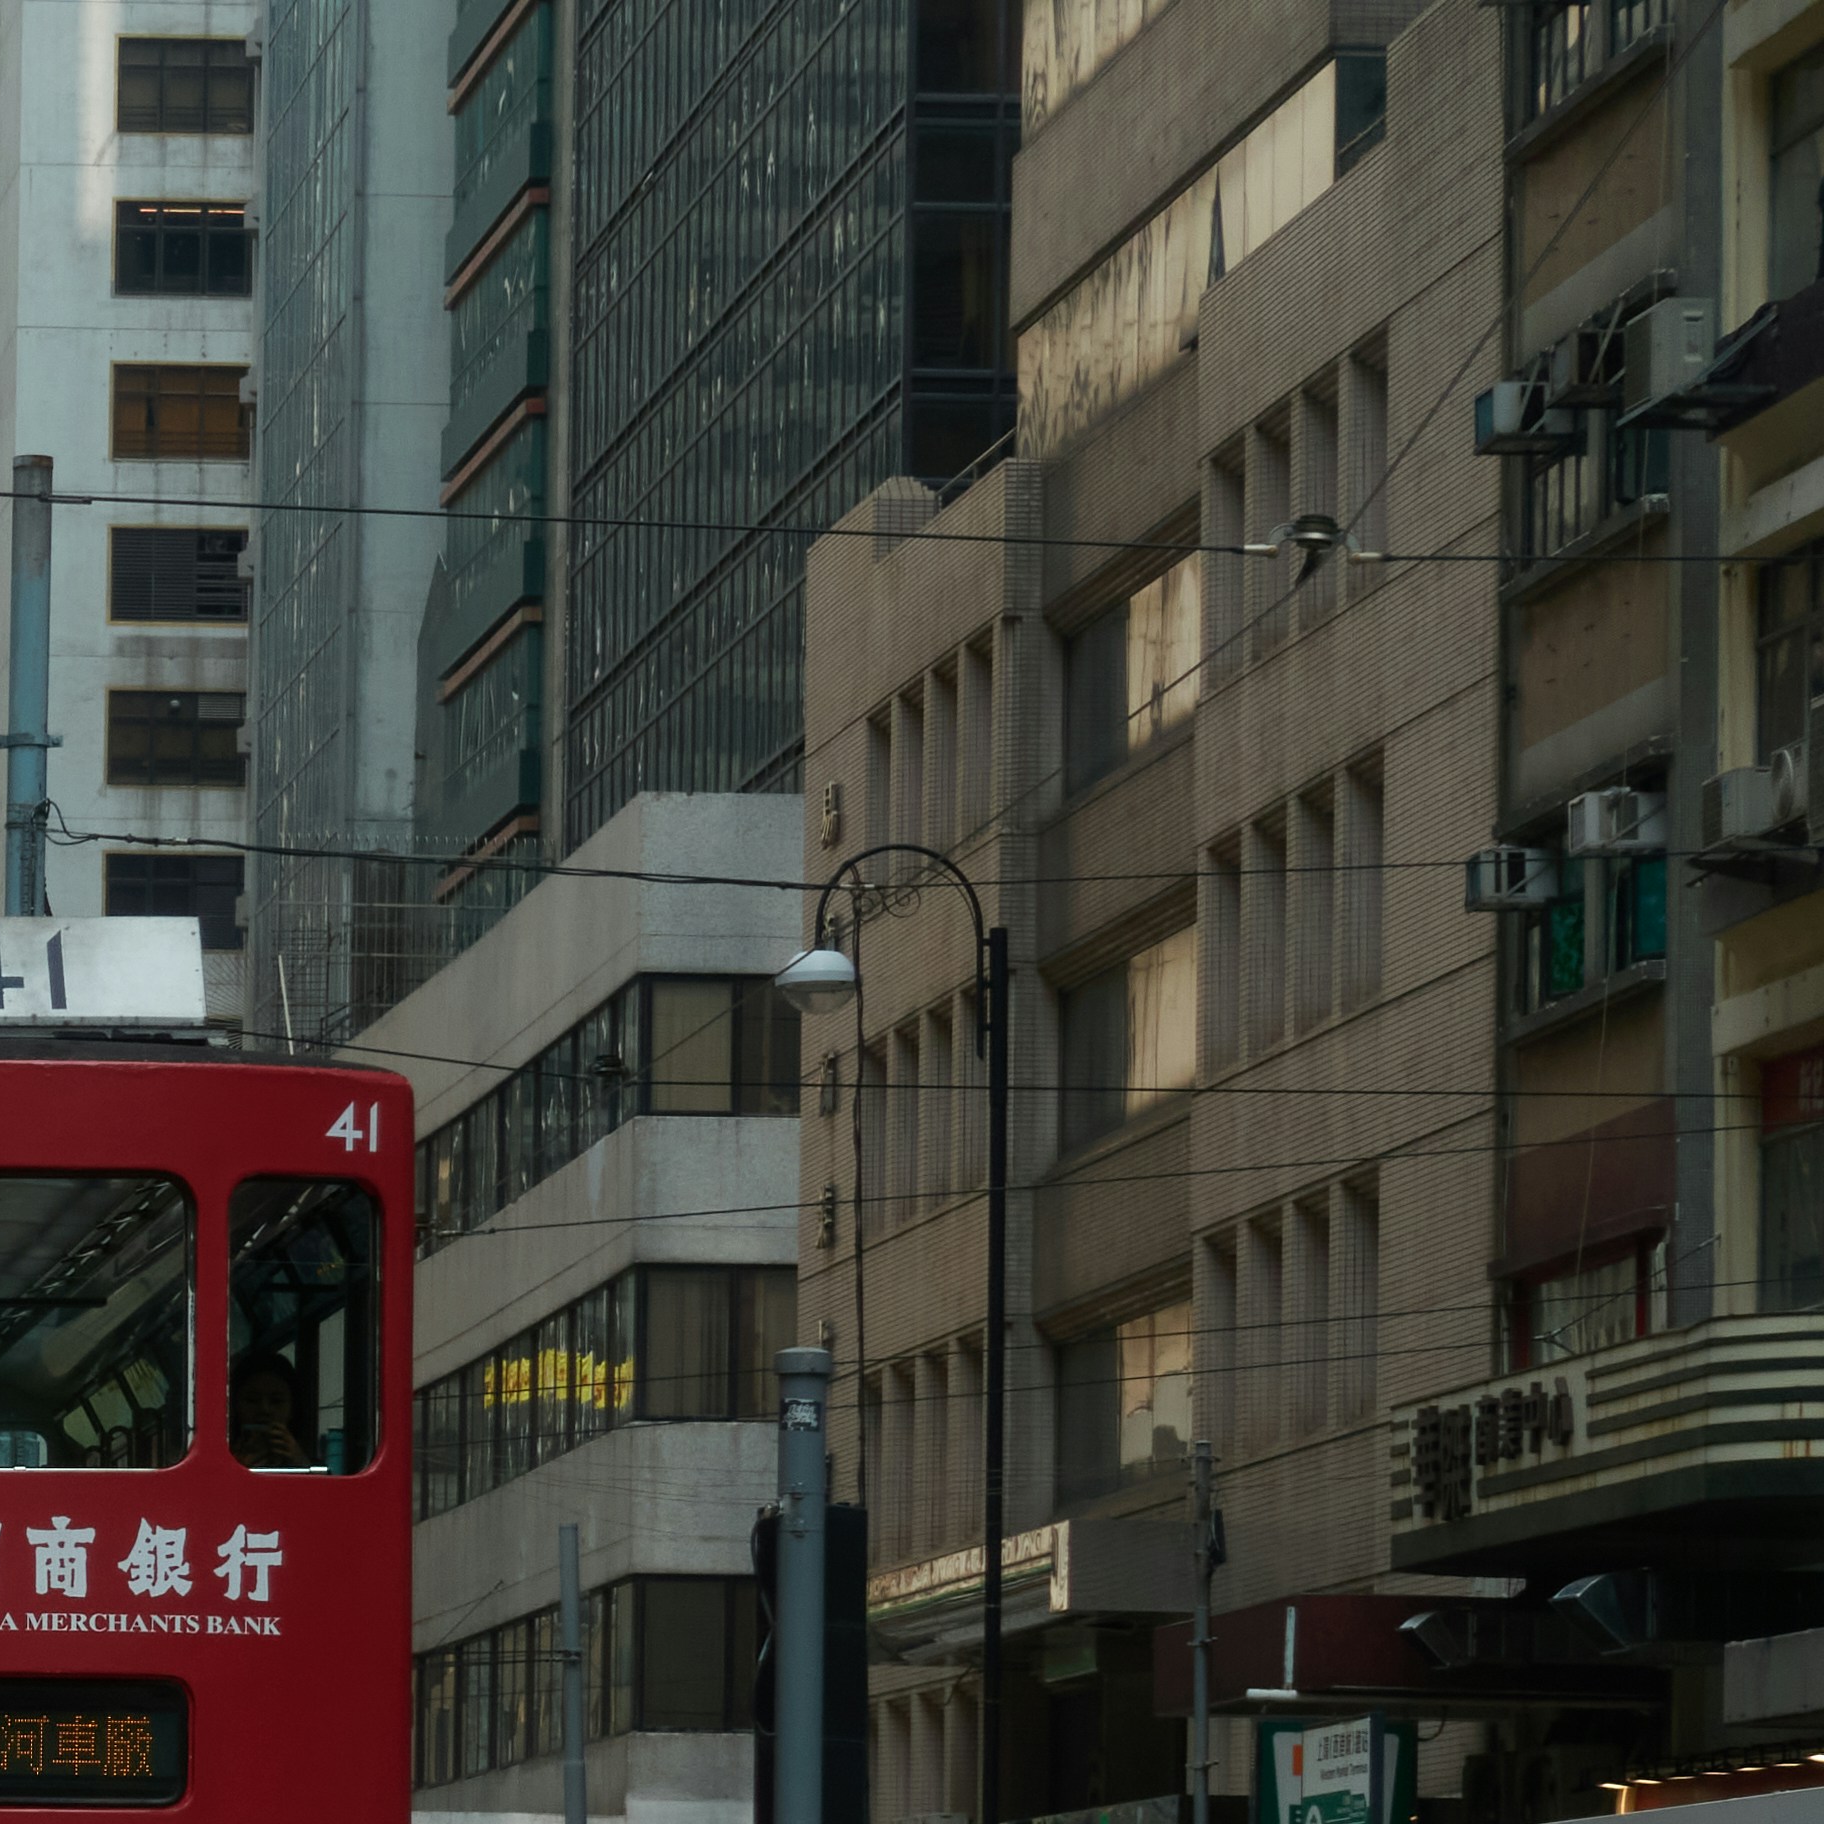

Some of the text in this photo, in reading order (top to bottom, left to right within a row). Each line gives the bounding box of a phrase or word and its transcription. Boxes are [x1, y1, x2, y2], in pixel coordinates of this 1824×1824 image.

[325, 1101, 379, 1152] 41
[24, 1611, 200, 1635] MERCHANTS
[205, 1614, 282, 1636] BANK
